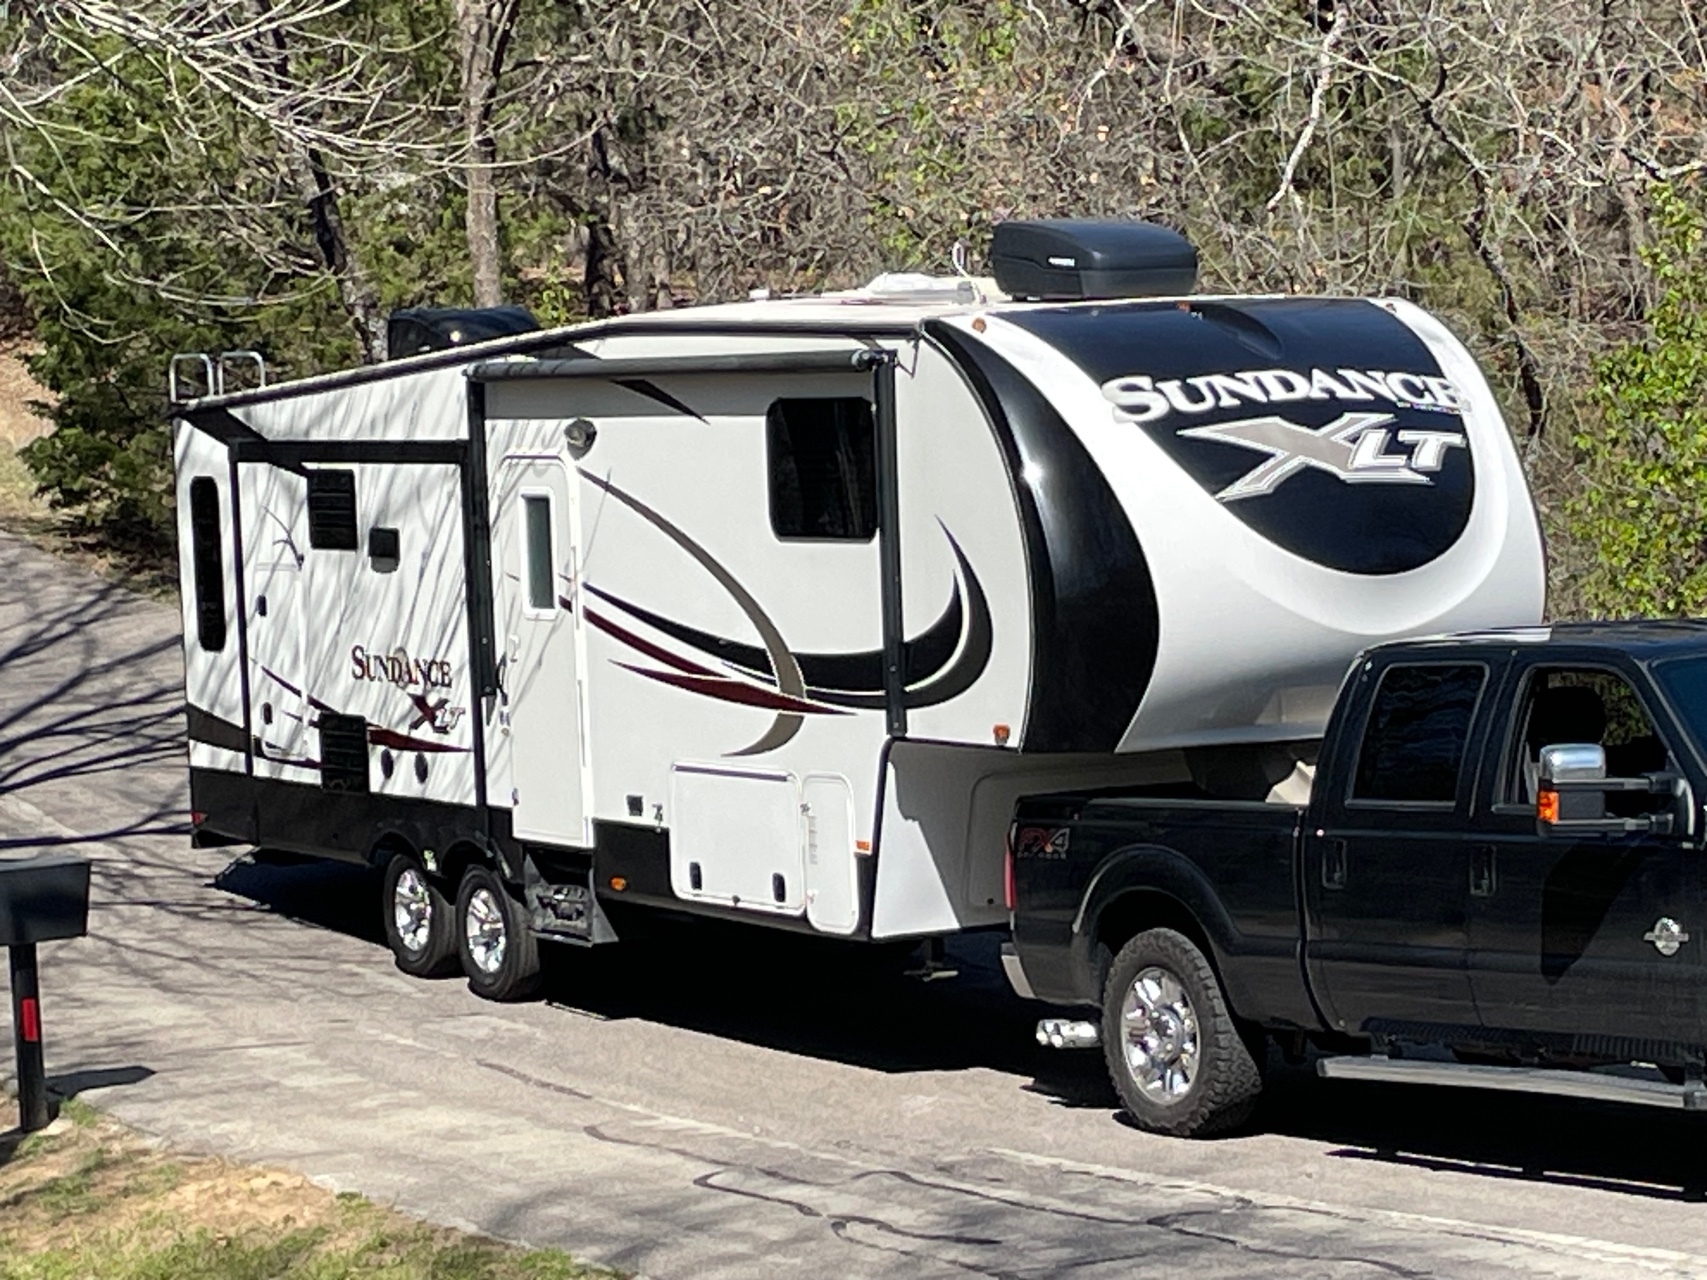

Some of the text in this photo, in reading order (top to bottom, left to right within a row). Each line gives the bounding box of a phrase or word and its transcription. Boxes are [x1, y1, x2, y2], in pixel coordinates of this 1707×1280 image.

[1100, 368, 1472, 424] SUNDANCE
[1175, 412, 1467, 503] XLT
[351, 644, 453, 689] SUNDANCE
[406, 691, 467, 736] XLT
